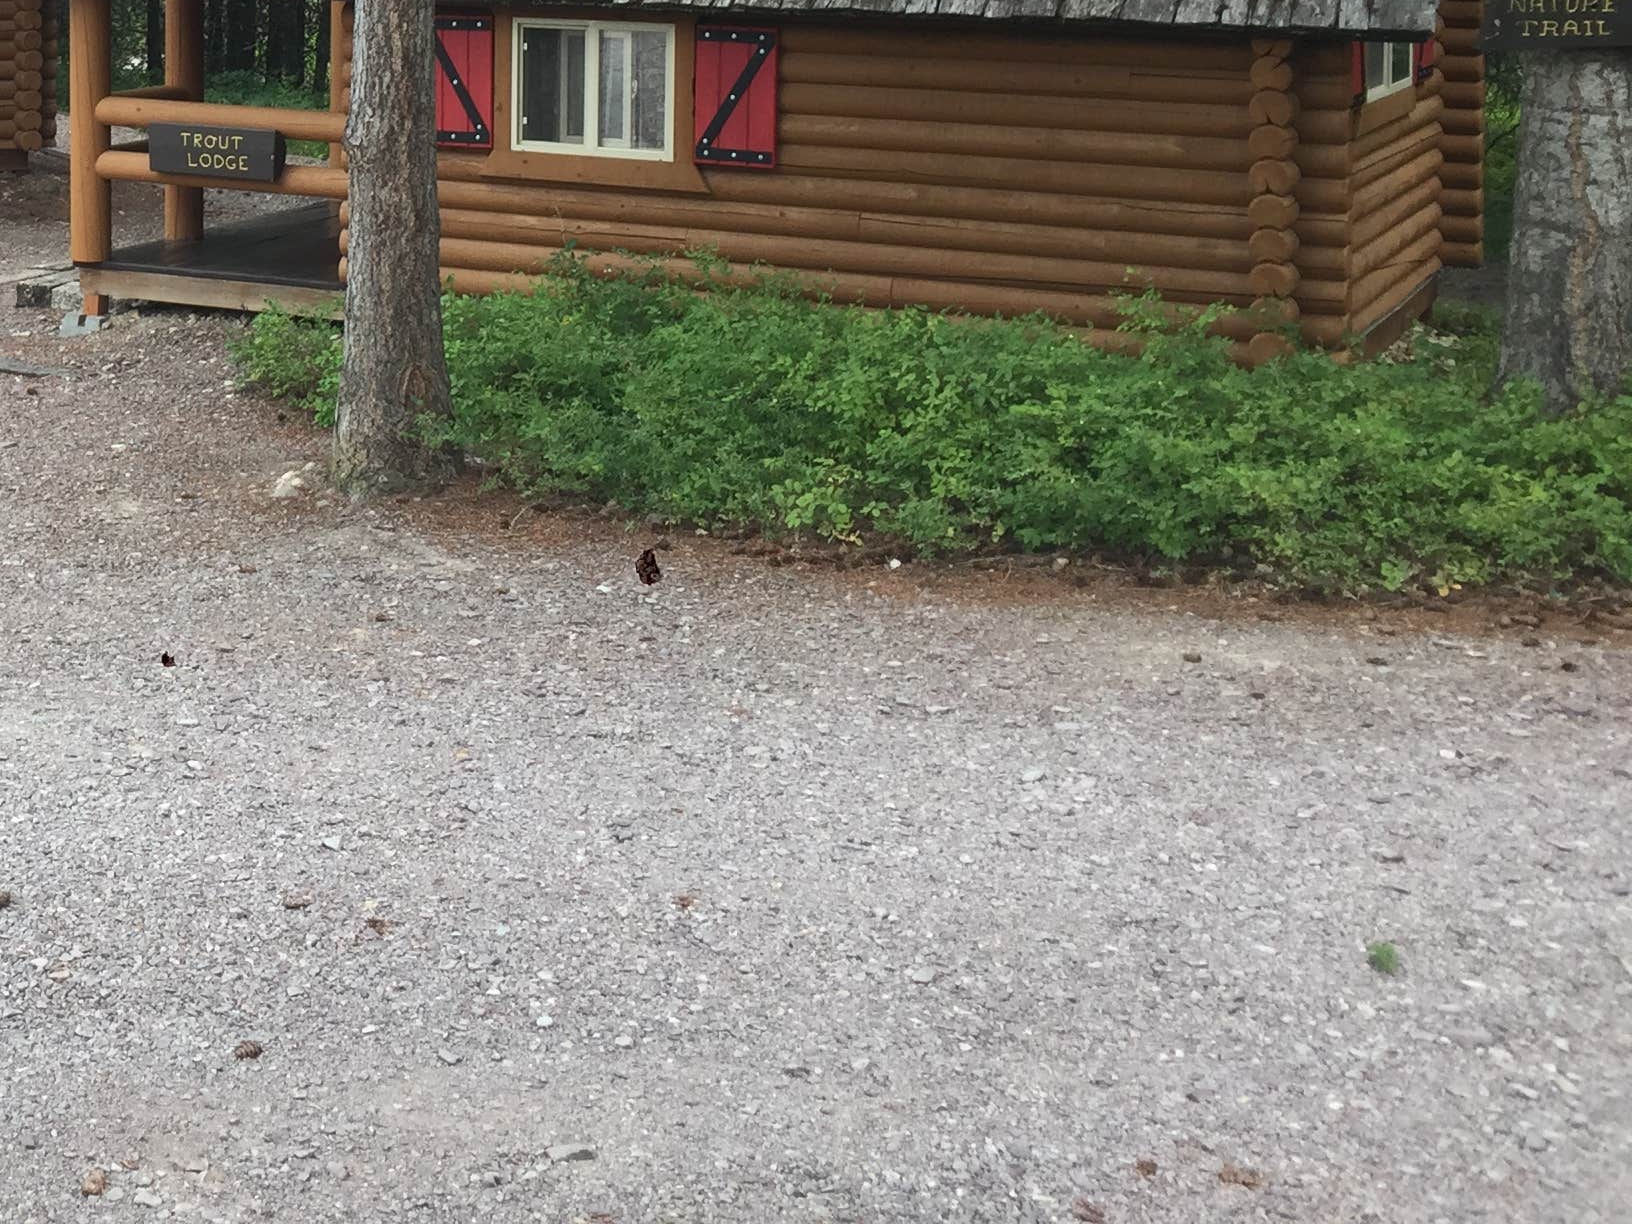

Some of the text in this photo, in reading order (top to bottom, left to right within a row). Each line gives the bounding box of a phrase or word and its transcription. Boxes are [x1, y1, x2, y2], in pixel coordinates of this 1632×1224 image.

[1516, 20, 1611, 37] TRAIL
[180, 132, 244, 150] TROUT
[187, 153, 249, 171] LODGE
